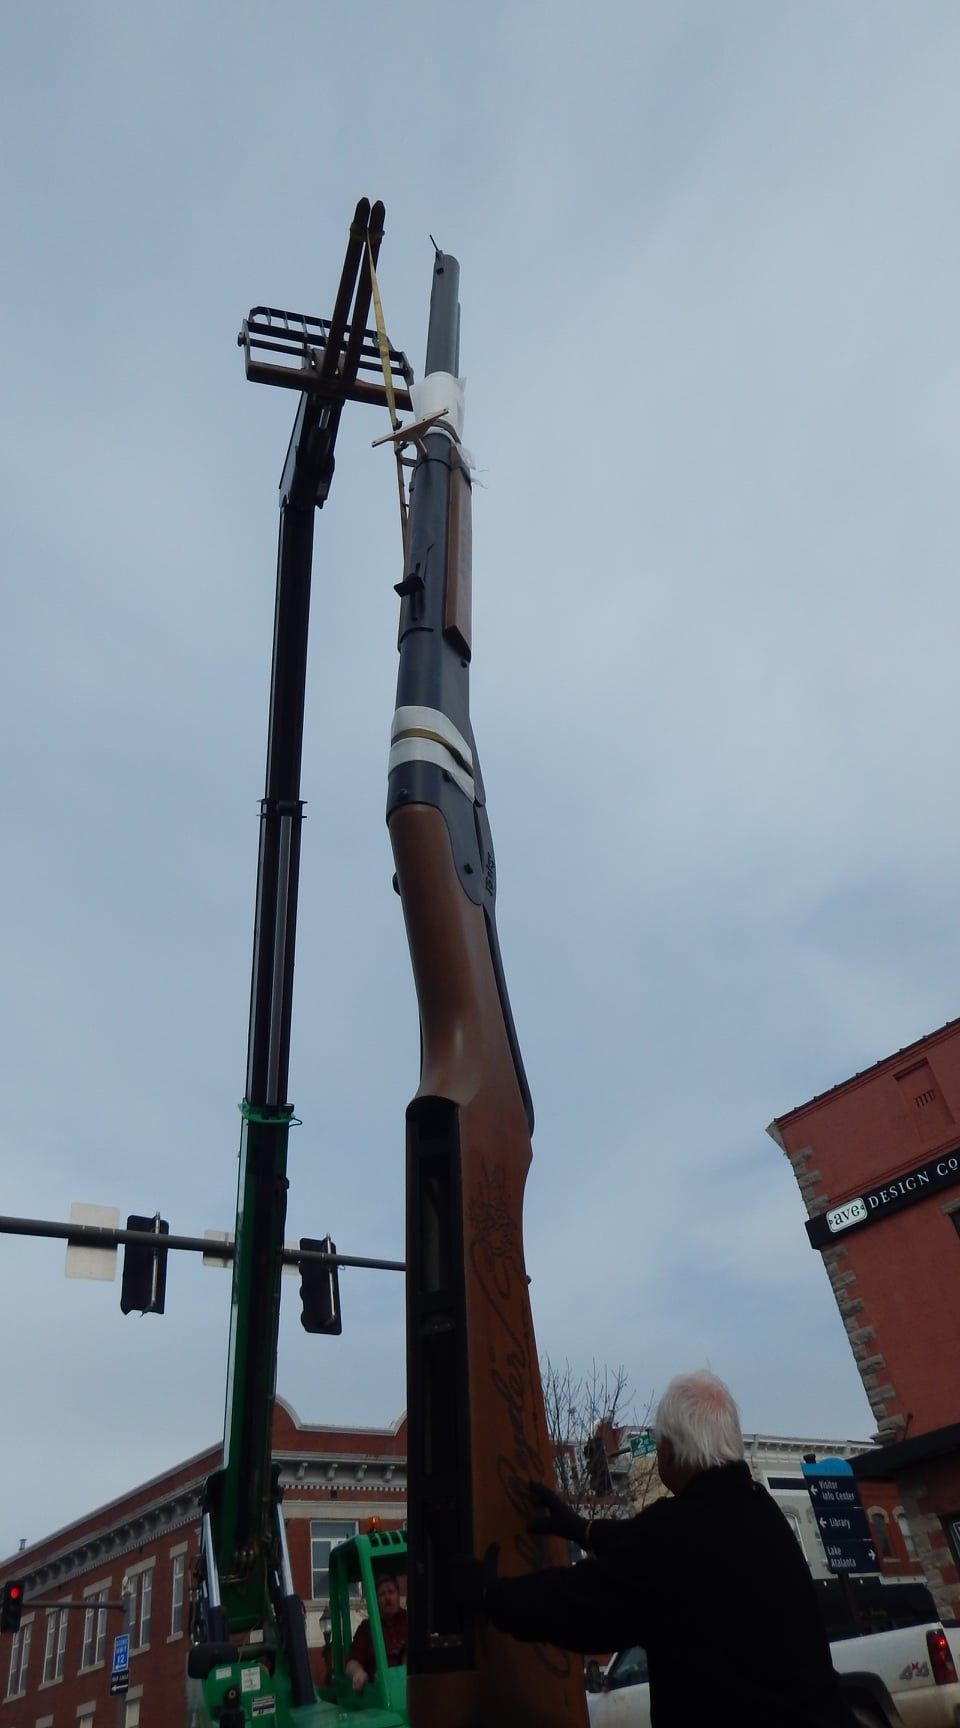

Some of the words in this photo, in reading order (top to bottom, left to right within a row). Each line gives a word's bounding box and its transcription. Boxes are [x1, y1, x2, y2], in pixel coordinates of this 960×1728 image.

[834, 1205, 859, 1225] ave
[868, 1171, 930, 1208] DESIGN
[818, 1480, 839, 1489] Visitor
[821, 1491, 835, 1501] Info
[836, 1492, 856, 1501] Center
[829, 1518, 851, 1529] Library
[827, 1546, 842, 1555] Lake
[831, 1558, 857, 1567] Atalanta
